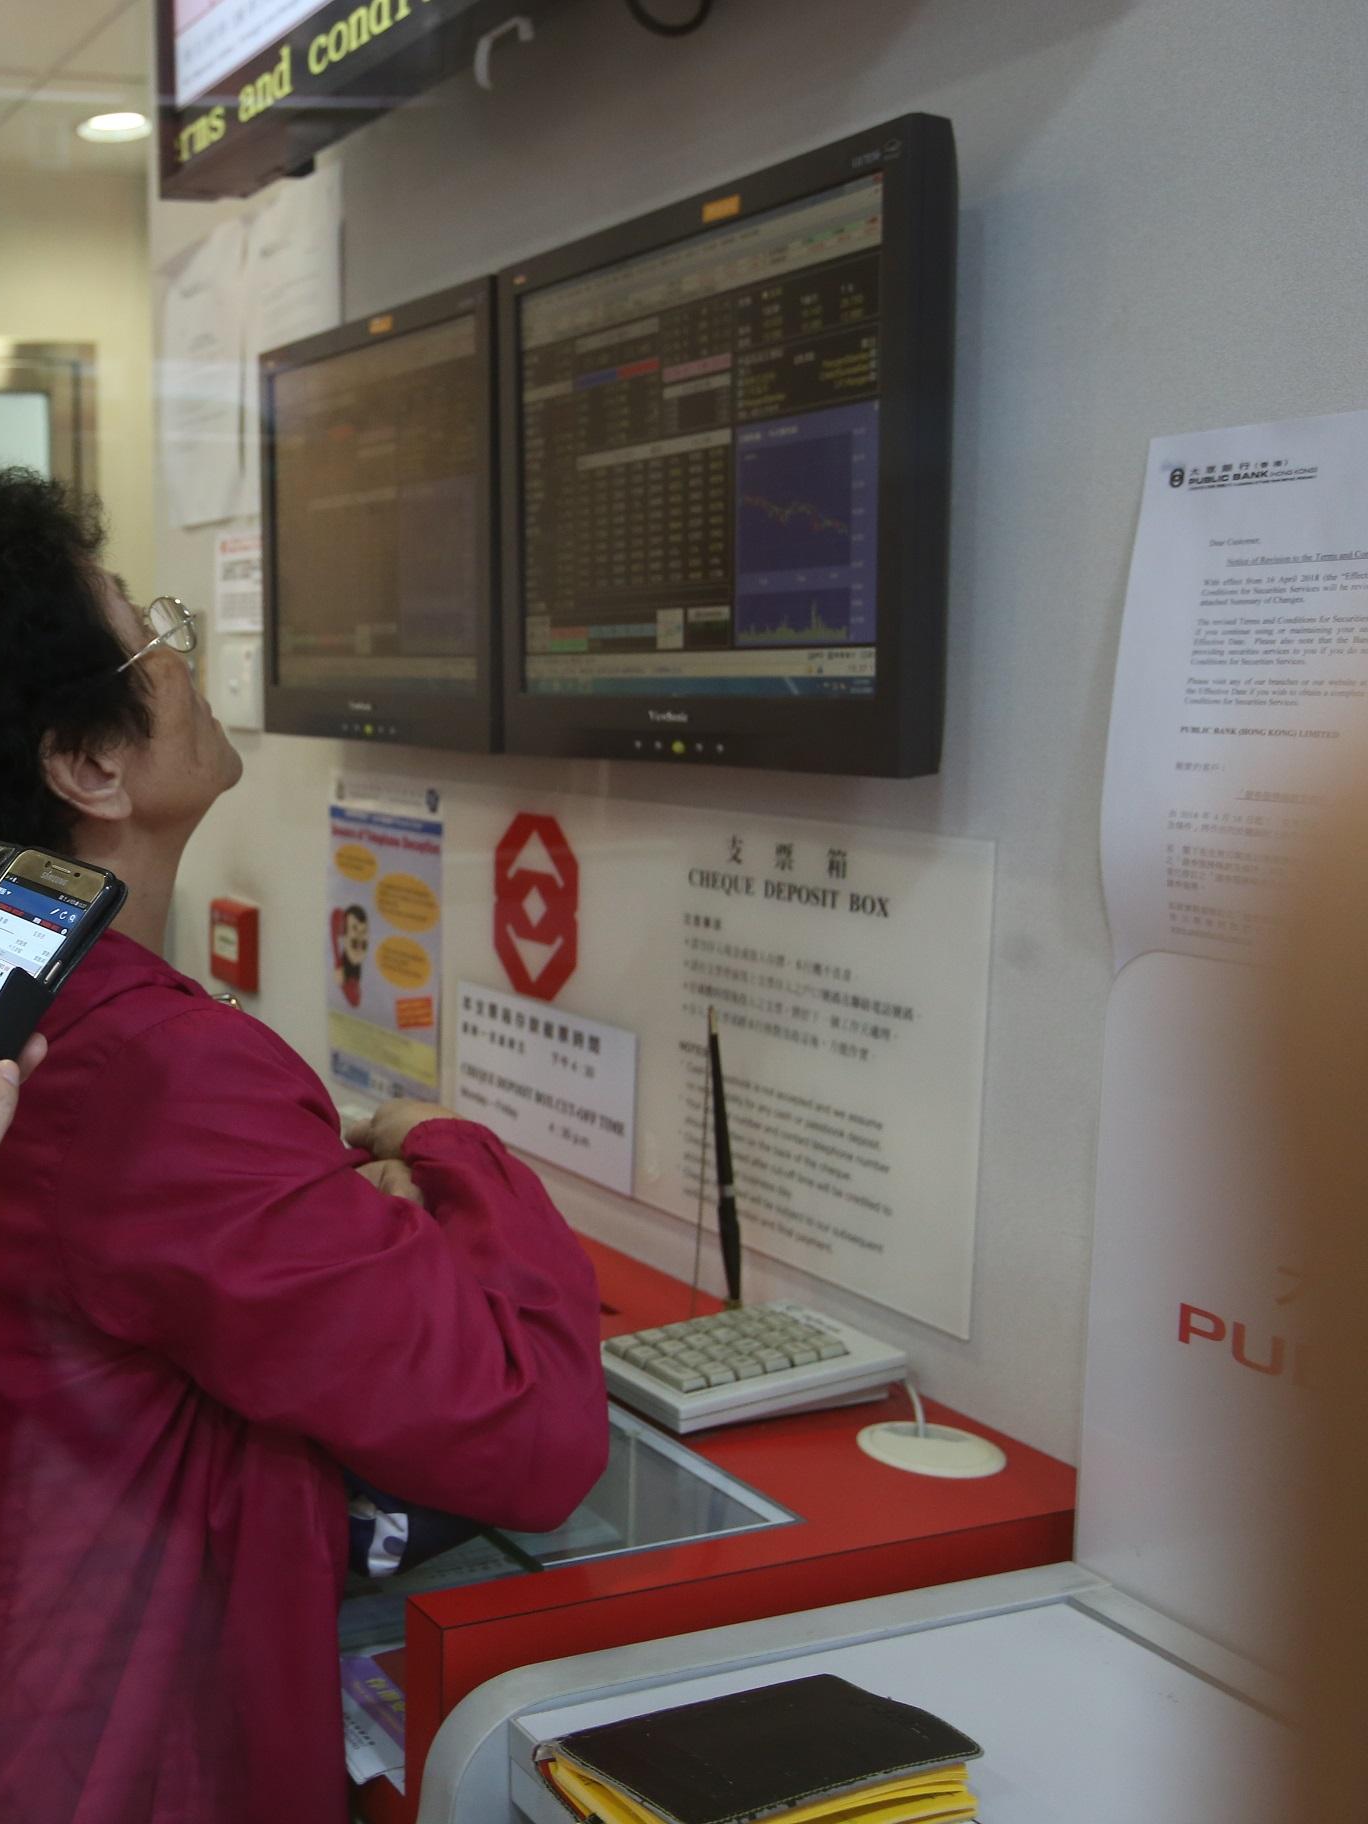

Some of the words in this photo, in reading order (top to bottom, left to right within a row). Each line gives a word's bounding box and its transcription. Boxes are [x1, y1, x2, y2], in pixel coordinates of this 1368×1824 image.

[175, 104, 226, 162] rms
[237, 44, 294, 123] and
[307, 0, 428, 76] condi
[1188, 474, 1229, 485] PUBLIC
[1233, 470, 1268, 481] BANK
[1209, 539, 1225, 547] Dear
[1315, 553, 1338, 561] Terms
[1340, 551, 1353, 560] and
[1246, 577, 1262, 585] from
[1280, 575, 1297, 584] April
[1201, 588, 1238, 596] Conditions
[1241, 587, 1251, 595] for
[1254, 586, 1286, 594] Securities
[1290, 585, 1320, 593] Services
[1230, 598, 1260, 606] Summary
[1277, 616, 1316, 624] Conditions
[1193, 638, 1224, 646] Effective
[1198, 688, 1229, 696] Effective
[1180, 726, 1210, 734] PUBLIC
[1214, 727, 1238, 735] BANK
[1299, 730, 1341, 739] LIMITED
[688, 868, 755, 896] CHEQUE
[764, 879, 840, 909] DEPOSIT
[849, 892, 890, 918] BOX
[461, 1062, 494, 1084] CHEQUE
[496, 1075, 533, 1101] DEPOSIT
[535, 1089, 554, 1108] BOX
[555, 1097, 597, 1126] CUT-OFF
[599, 1113, 625, 1137] TIME
[815, 1101, 831, 1113] and
[848, 1111, 883, 1130] assume
[855, 1155, 890, 1173] number
[883, 1206, 893, 1216] to
[833, 1226, 885, 1252] subsequent
[1178, 1302, 1300, 1381] PU
